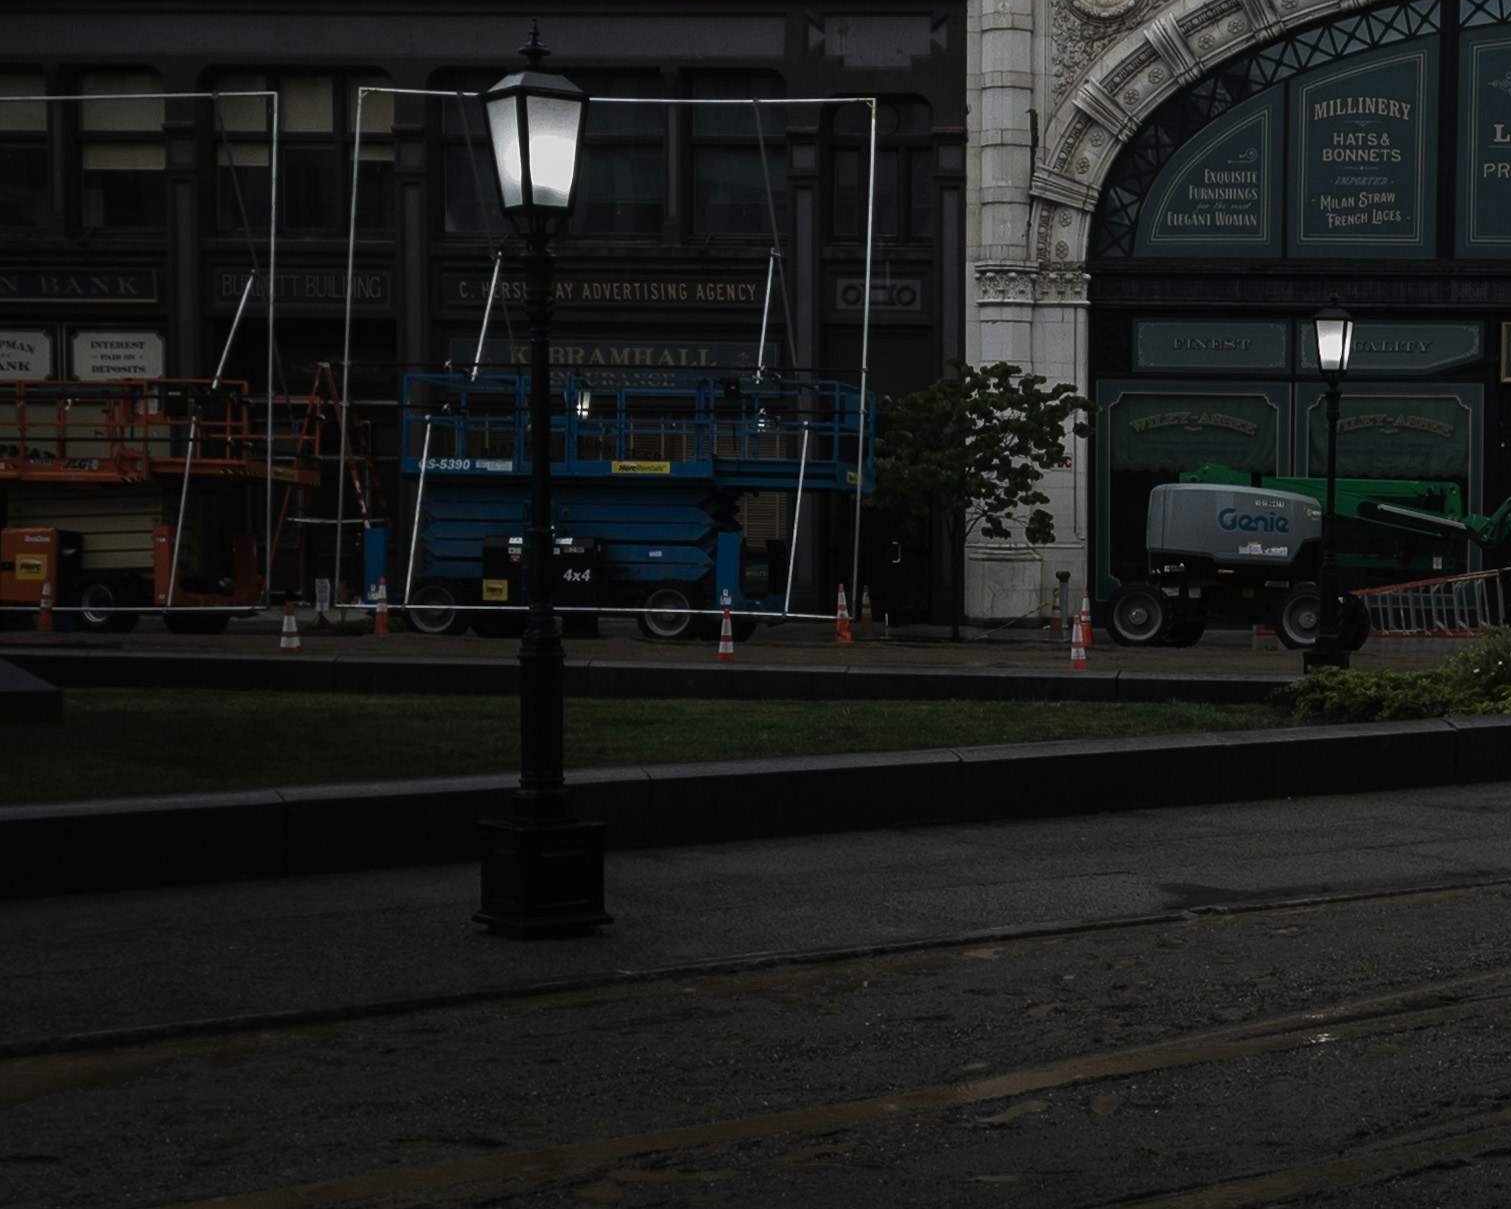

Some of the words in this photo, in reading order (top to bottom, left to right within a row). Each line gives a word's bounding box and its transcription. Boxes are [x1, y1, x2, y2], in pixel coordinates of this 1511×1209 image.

[1313, 96, 1411, 120] MILLINERY
[1321, 148, 1402, 162] BONNETS
[1204, 168, 1258, 184] EXQUISITE
[1188, 184, 1258, 200] FURNISHINGS
[1319, 194, 1355, 211] MILAN
[1358, 191, 1396, 207] STRAW
[1167, 211, 1212, 226] ELEGANT
[1215, 211, 1257, 226] WOMAN
[1326, 212, 1368, 228] FRENCH
[1371, 210, 1401, 224] LACES
[40, 275, 137, 295] BANK
[222, 275, 300, 297] BURDTT
[582, 282, 688, 300] ADVERTISING
[696, 282, 757, 301] AGENCY
[90, 341, 145, 350] INTEREST
[1173, 338, 1253, 351] FINEST
[1353, 340, 1433, 353] UALITY
[549, 346, 717, 367] BRAMHALL
[92, 364, 145, 374] DEPOSITS
[1325, 413, 1455, 439] ILEY-ASBEE
[1218, 508, 1289, 533] Genie
[562, 568, 592, 582] 4x4
